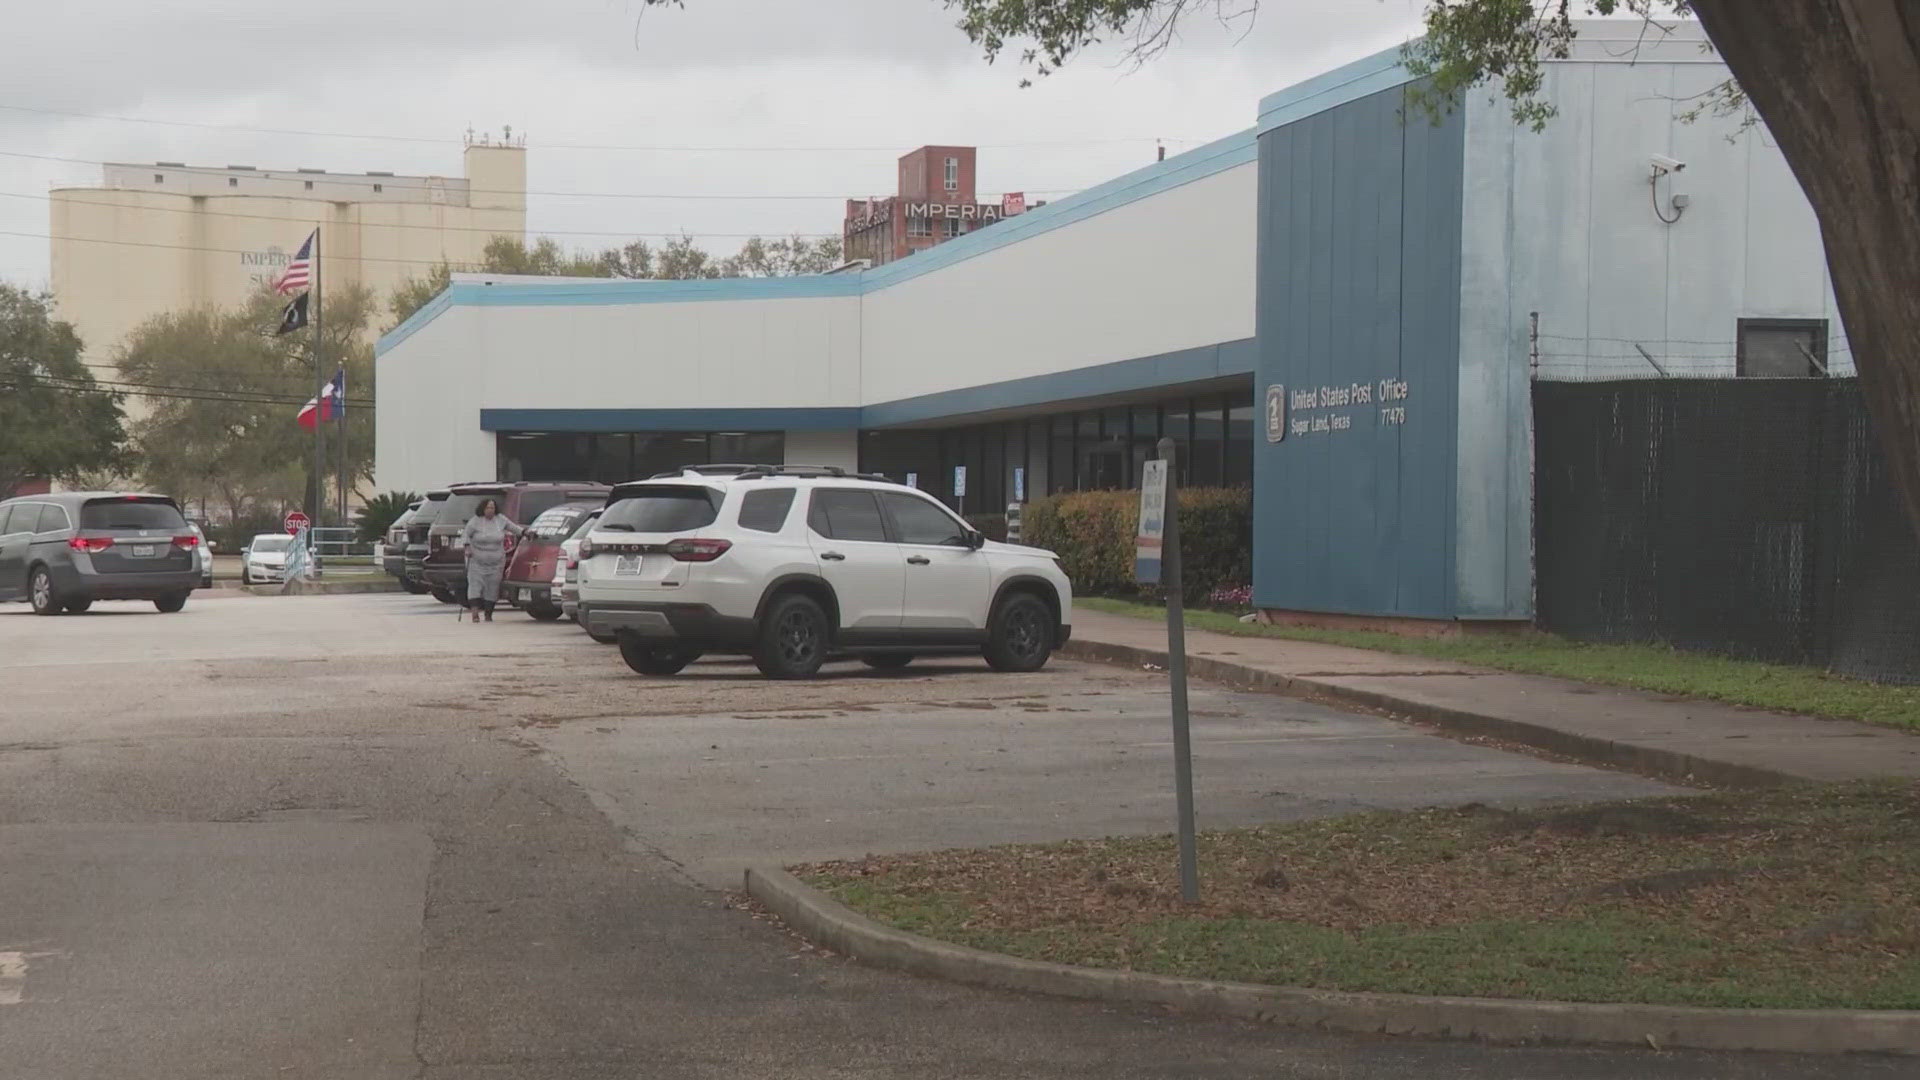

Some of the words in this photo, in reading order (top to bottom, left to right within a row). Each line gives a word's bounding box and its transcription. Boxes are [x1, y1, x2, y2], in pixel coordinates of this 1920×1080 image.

[240, 252, 293, 266] IMPERI
[1291, 387, 1317, 411] United
[1320, 385, 1349, 408] States
[1351, 381, 1372, 404] Post
[1378, 377, 1408, 403] Office
[1291, 417, 1309, 436] Sugar
[1311, 415, 1330, 433] Land,
[1331, 413, 1350, 430] Texas
[1381, 406, 1405, 426] 77478
[286, 519, 309, 529] STOP
